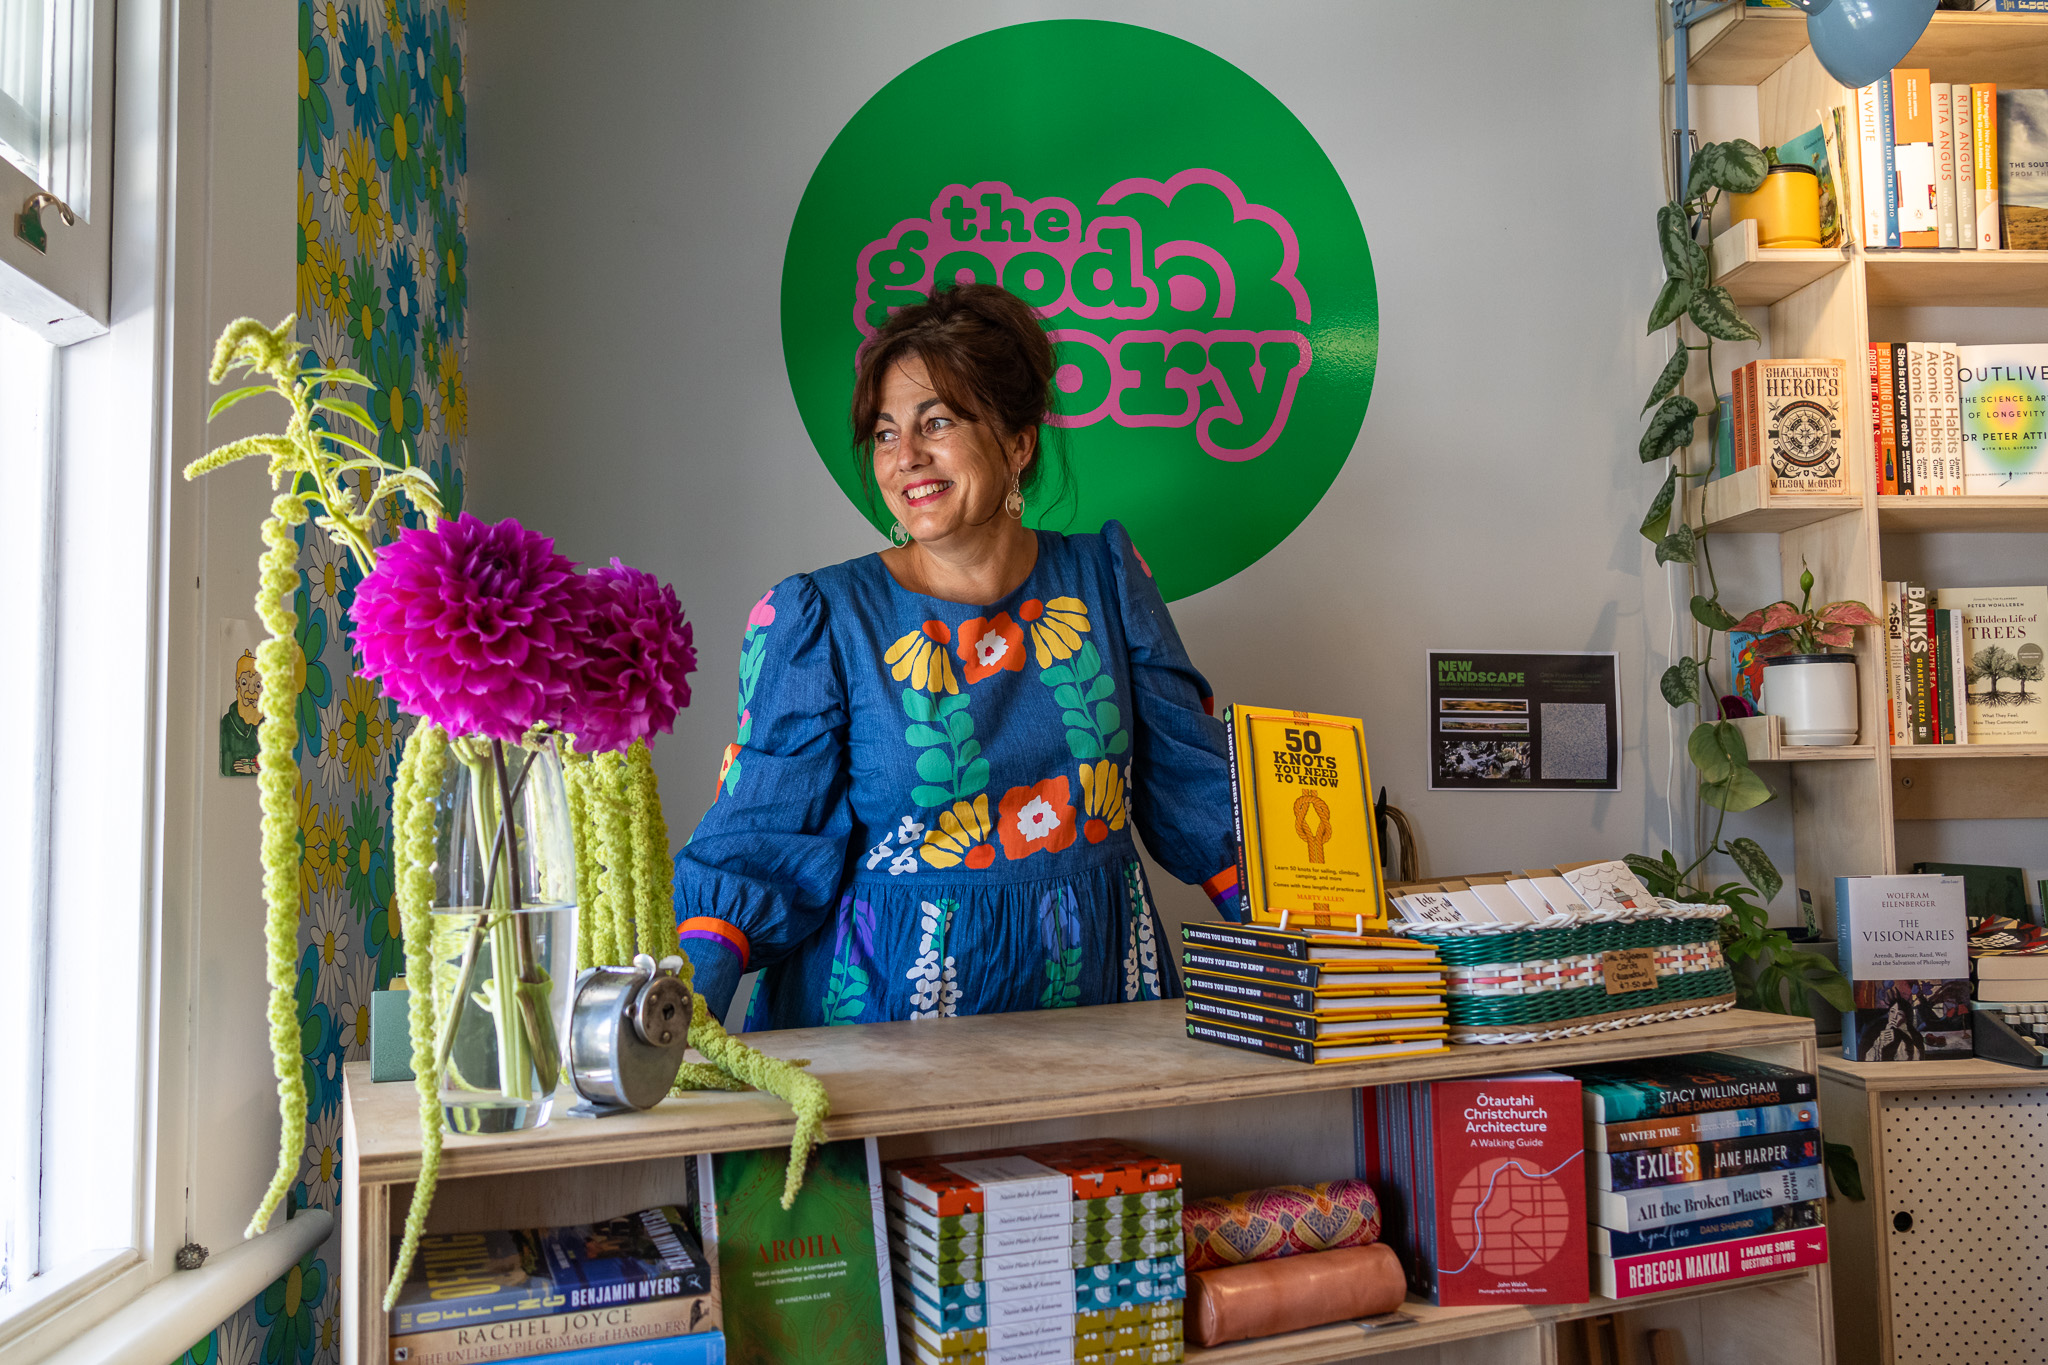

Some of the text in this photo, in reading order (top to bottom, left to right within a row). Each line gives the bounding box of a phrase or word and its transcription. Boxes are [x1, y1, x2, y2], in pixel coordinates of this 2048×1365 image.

[1938, 94, 1948, 124] RITA
[1958, 96, 1967, 125] RITA
[1864, 101, 1876, 142] WHITE
[1940, 130, 1951, 180] ANGUS
[1960, 132, 1970, 181] ANGUS
[942, 193, 1070, 243] the
[1897, 348, 1907, 366] She
[1766, 367, 1838, 378] SHACKLETON'S
[1879, 358, 1892, 400] DRINKING
[1898, 368, 1907, 376] is
[1958, 366, 2048, 382] OUTLIVE
[1767, 378, 1838, 398] HEROES
[1899, 378, 1908, 393] not
[1897, 395, 1907, 416] your
[1911, 351, 1927, 453] Atomic Habits
[1927, 351, 1942, 453] Atomic Habits
[1943, 351, 1959, 453] Atomic Habits
[1882, 404, 1893, 434] GAME
[1901, 419, 1910, 447] rehab
[1771, 480, 1804, 489] WILSON
[1890, 617, 1902, 640] Soil
[1908, 588, 1928, 653] BANKS
[1976, 615, 2007, 623] Hidden
[2028, 614, 2037, 622] of
[1968, 626, 2026, 639] TREES
[1438, 660, 1472, 672] NEW
[1438, 672, 1525, 683] LANDSCAPE
[1895, 675, 1903, 699] Matthew
[1917, 659, 1926, 723] GRANTLEE KIEZA
[1285, 728, 1322, 754] 50
[1273, 751, 1337, 769] KNOTS
[1274, 764, 1338, 778] YOU NEED
[1275, 773, 1339, 788] TO KNOW
[1899, 919, 1919, 928] THE
[1221, 934, 1234, 942] NEED
[1242, 938, 1256, 946] KNOW
[1862, 930, 1955, 942] VISIONARIES
[1476, 1093, 1534, 1106] Ōtautahi
[1660, 1081, 1777, 1104] STACY WILLINGHAM
[1660, 1092, 1780, 1115] ALL THE DANGEROUS THINGS
[1464, 1107, 1547, 1120] Christchurch
[1466, 1121, 1547, 1133] Architecture
[1620, 1130, 1656, 1142] WINTER
[1658, 1127, 1681, 1138] TIME
[1479, 1138, 1515, 1149] Walking
[1516, 1137, 1543, 1147] Guide
[1636, 1145, 1788, 1180] EXILES JANE HARPER
[1782, 1174, 1791, 1200] JOHN
[1789, 1170, 1798, 1200] BOYNE
[1638, 1187, 1772, 1222] All the Broken Places
[1700, 1219, 1754, 1234] DANI SHAPIRO
[756, 1234, 841, 1265] AROHA
[1740, 1240, 1795, 1258] I HAVE SOME
[1629, 1250, 1730, 1289] REBECCA MAKKAI
[1741, 1256, 1773, 1271] QUESTIONS
[1783, 1252, 1796, 1263] YOU
[571, 1282, 636, 1307] BENJAMIN
[638, 1276, 680, 1299] MYERS
[458, 1308, 632, 1346] RACHEL JOYCE
[447, 1342, 513, 1362] UNLIKELY
[516, 1332, 596, 1356] PILGRIMAGE
[599, 1330, 609, 1341] of
[613, 1323, 662, 1338] HAROLD
[666, 1320, 688, 1332] FRY
